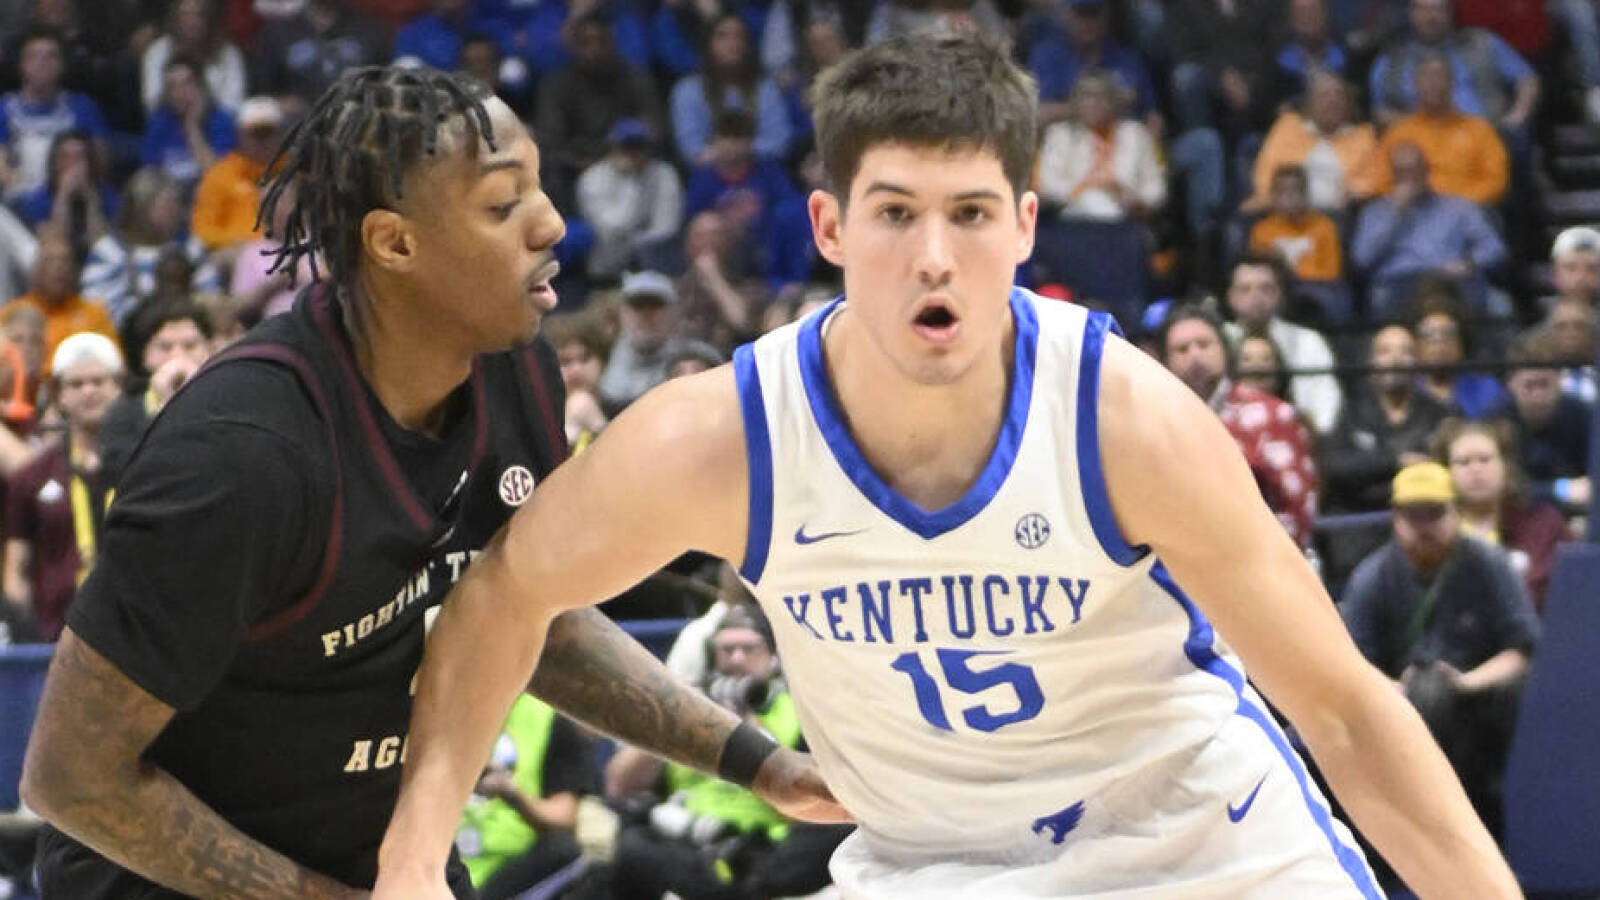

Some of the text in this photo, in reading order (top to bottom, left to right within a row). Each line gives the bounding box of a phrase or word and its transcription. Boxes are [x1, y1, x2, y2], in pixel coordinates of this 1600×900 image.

[501, 469, 532, 503] SEC
[1015, 514, 1049, 547] SEC
[783, 574, 1091, 644] KENTUCKY
[890, 648, 1046, 733] 15
[343, 734, 409, 772] AG
